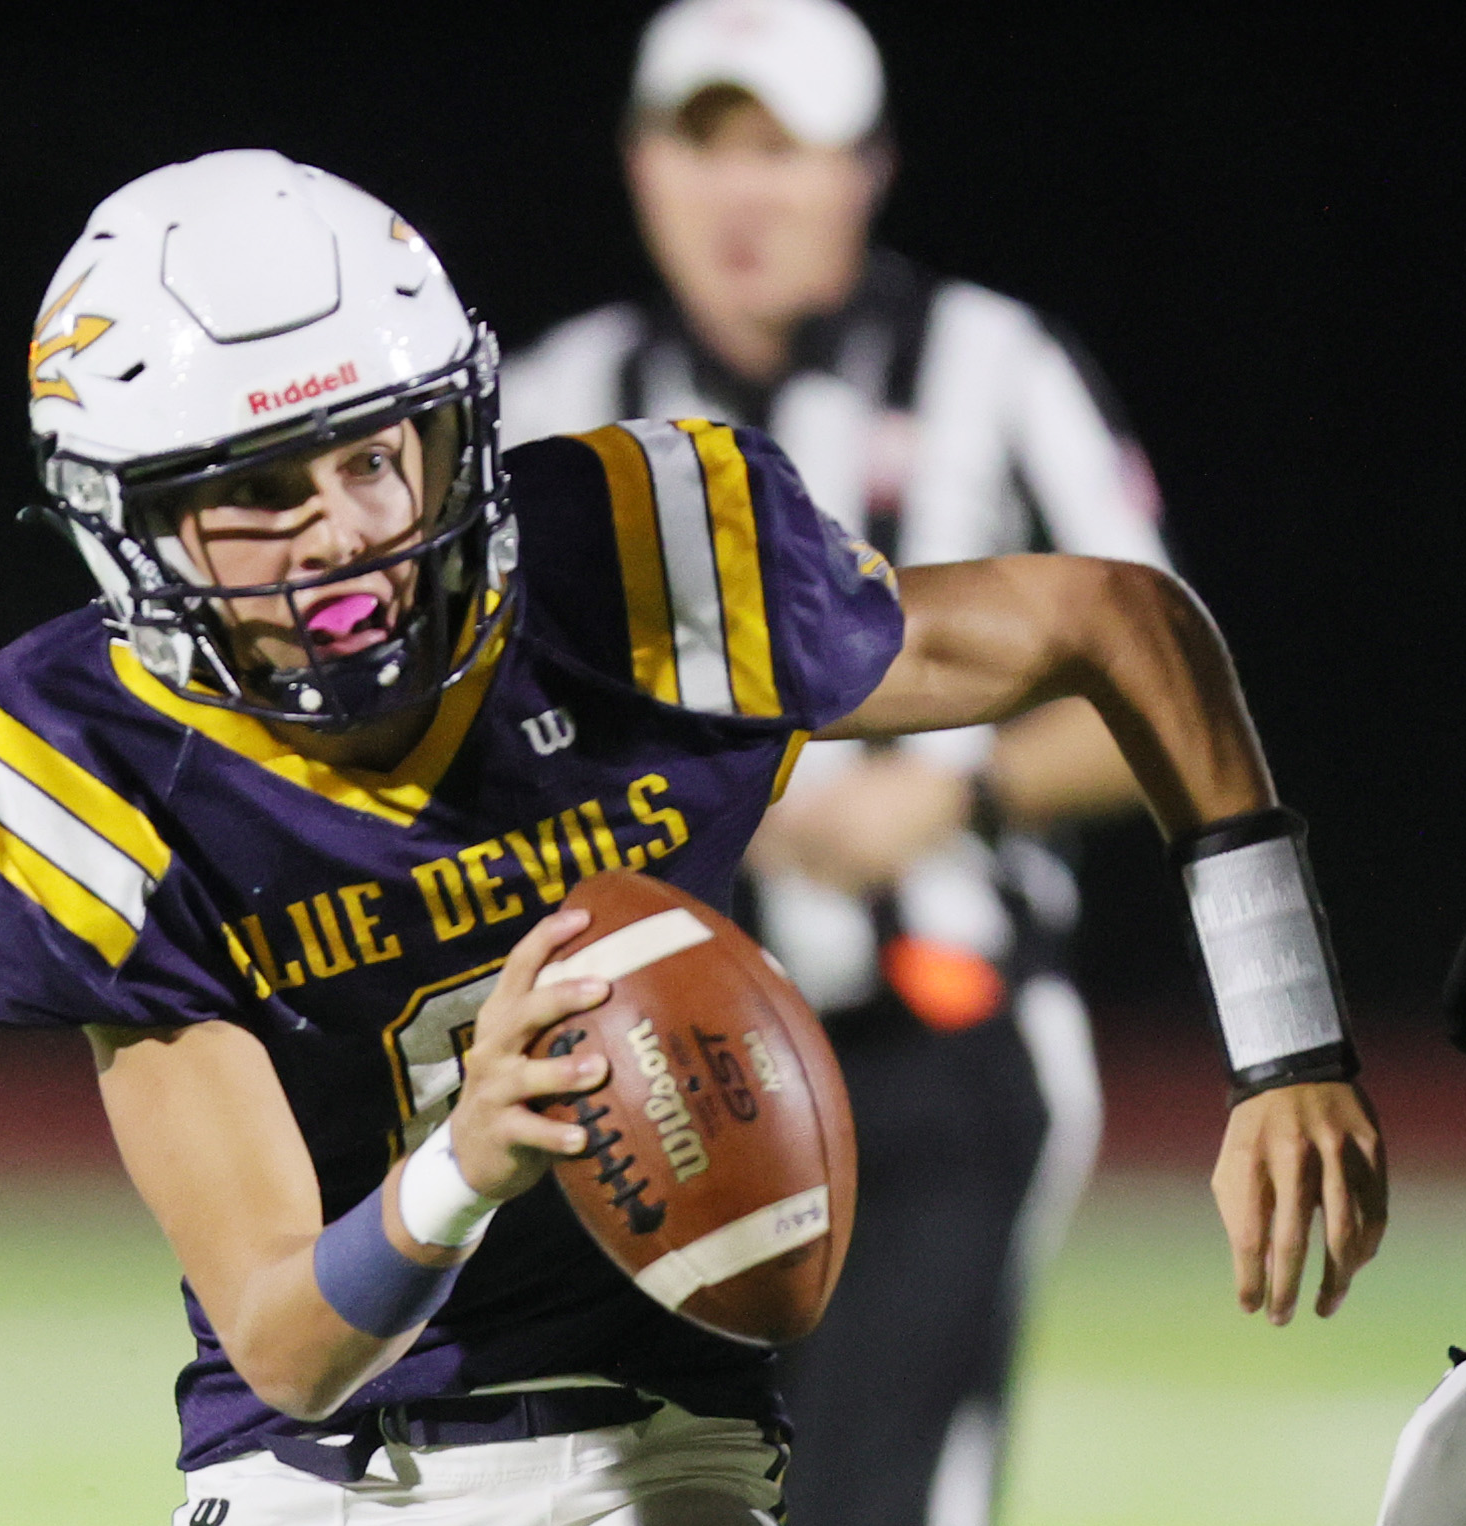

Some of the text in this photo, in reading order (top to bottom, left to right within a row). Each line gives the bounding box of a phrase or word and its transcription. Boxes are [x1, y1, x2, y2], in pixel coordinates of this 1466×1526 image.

[247, 361, 359, 415] Riddell
[410, 772, 691, 942] DEVILS
[627, 1017, 711, 1185] Wilson
[689, 1021, 760, 1123] GST
